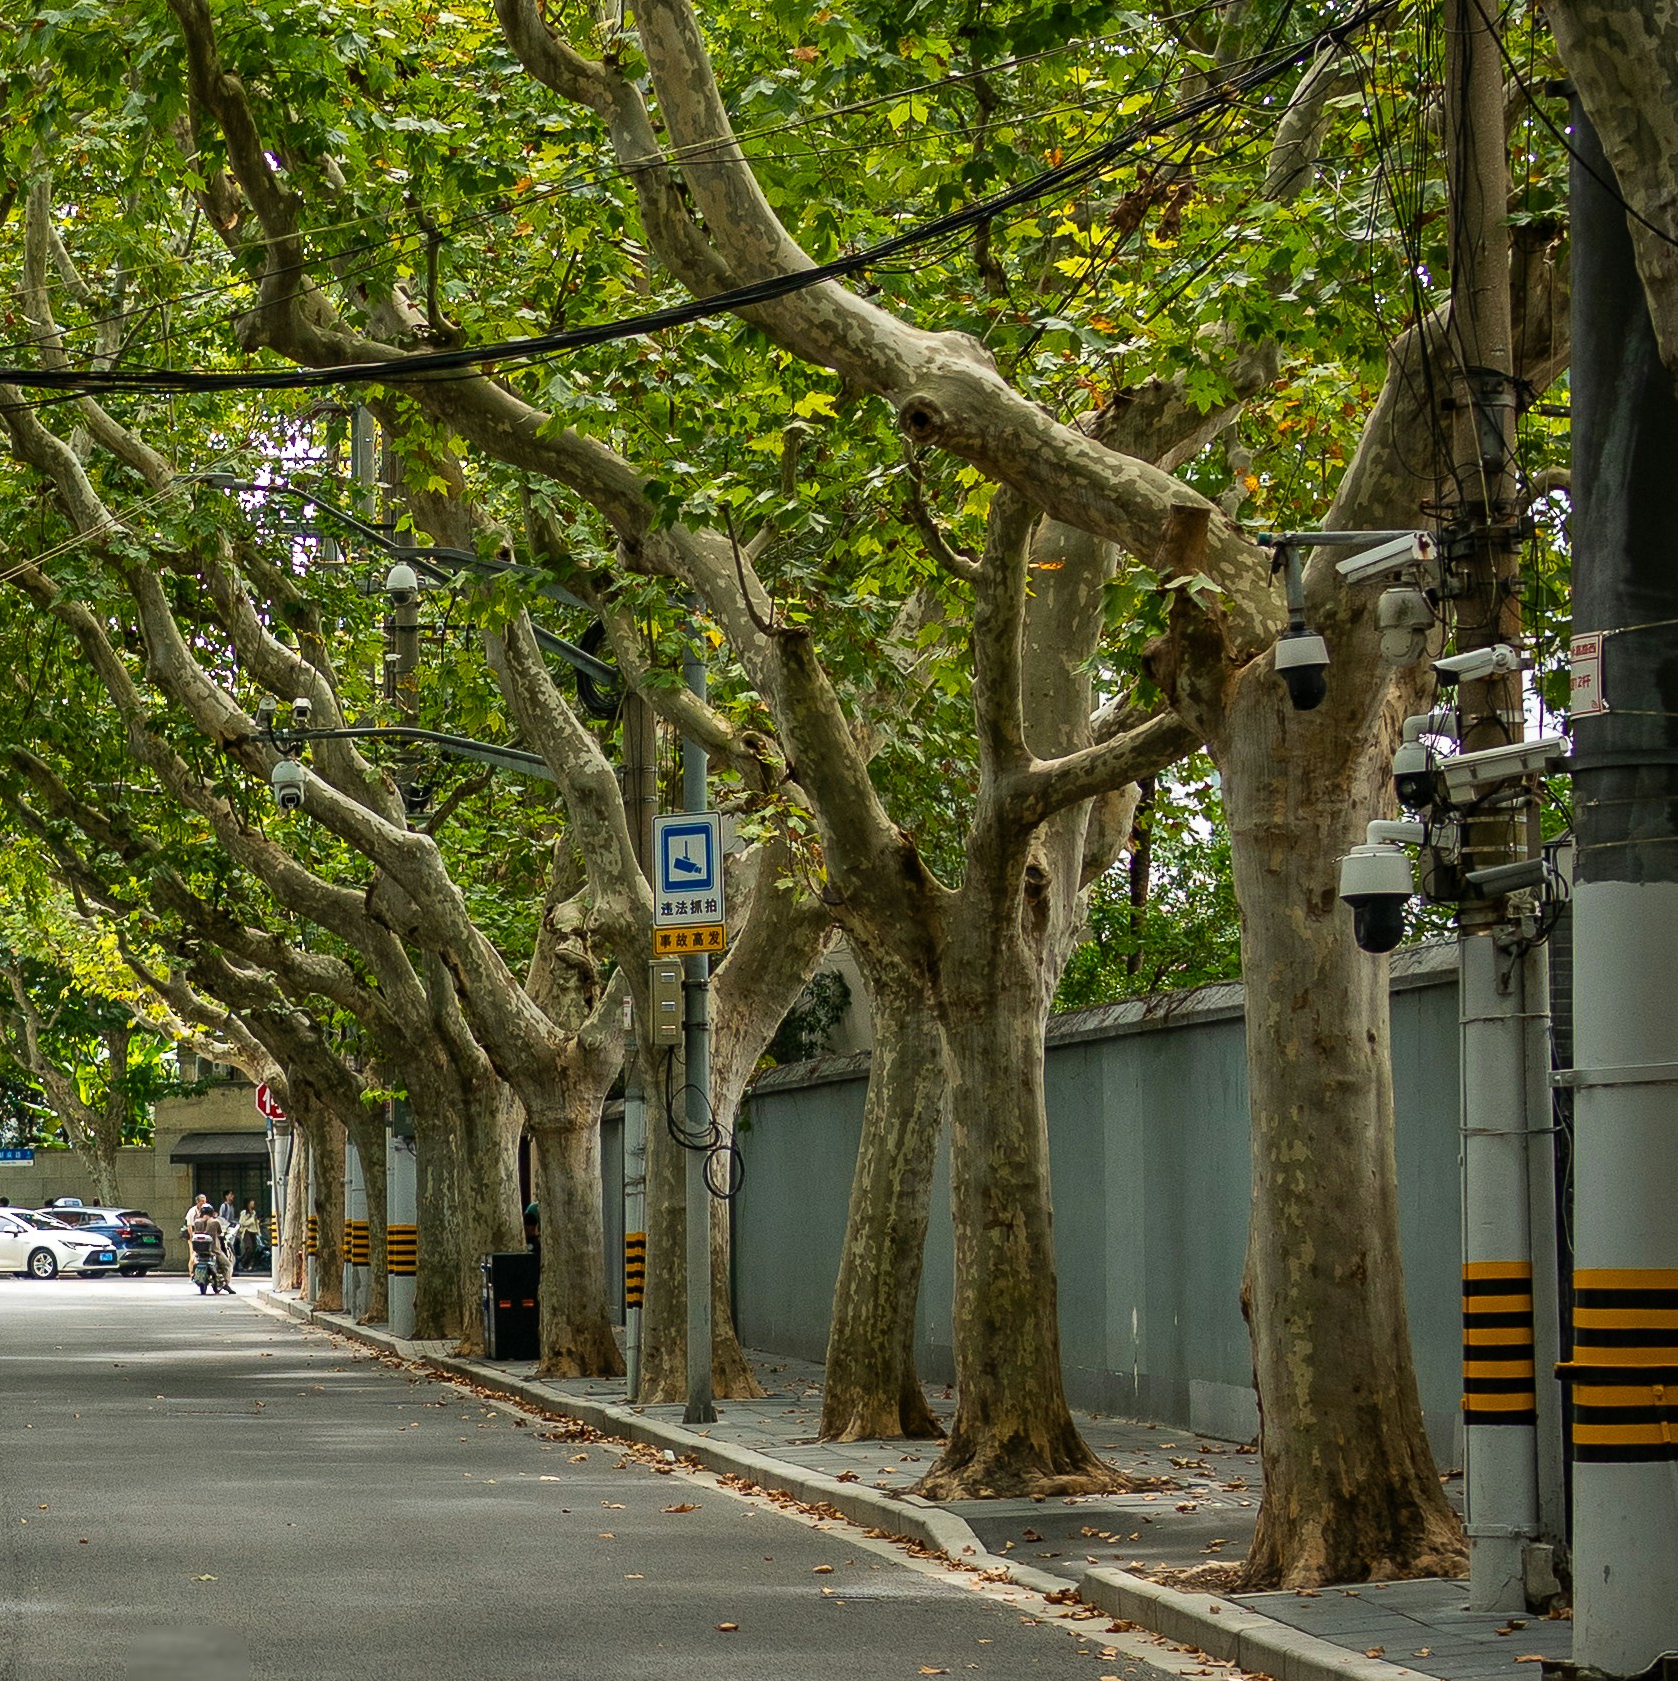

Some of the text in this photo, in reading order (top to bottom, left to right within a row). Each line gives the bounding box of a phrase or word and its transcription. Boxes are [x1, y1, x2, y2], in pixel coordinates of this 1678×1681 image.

[661, 898, 718, 916] 违法抓拍
[659, 930, 721, 949] 事故高发
